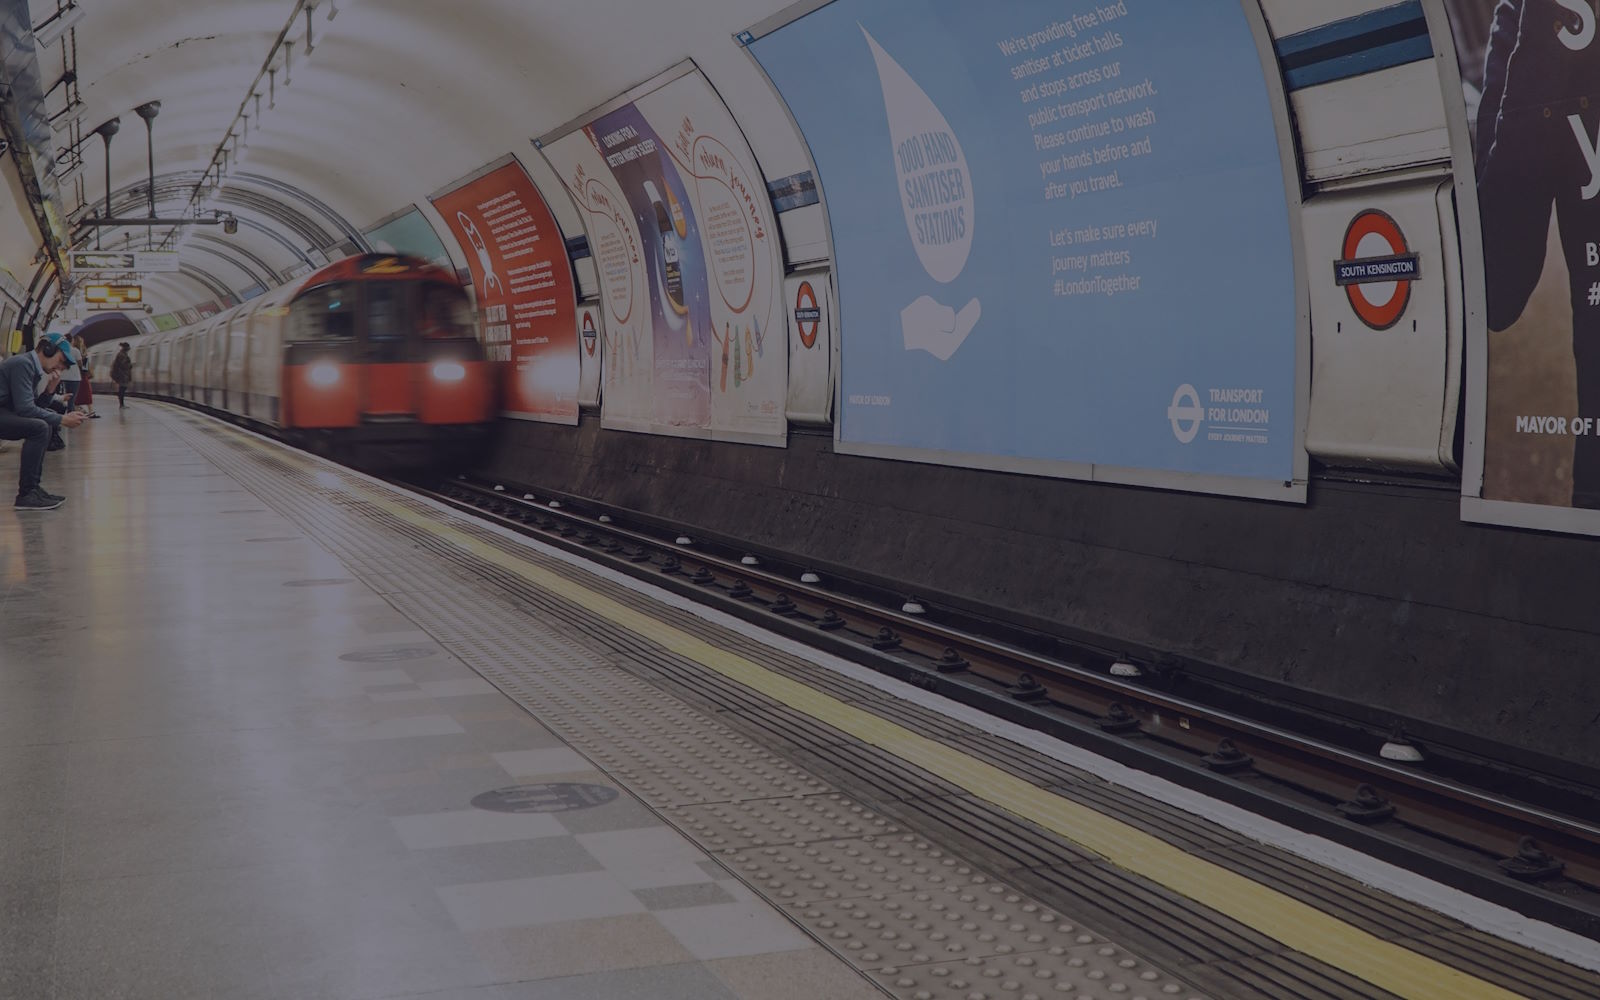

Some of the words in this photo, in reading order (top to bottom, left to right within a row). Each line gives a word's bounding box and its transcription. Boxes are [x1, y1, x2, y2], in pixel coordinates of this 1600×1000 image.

[997, 37, 1028, 57] We're
[1027, 22, 1077, 51] providing
[1073, 12, 1099, 31] free
[1098, 0, 1128, 20] hand
[1010, 56, 1050, 80] sanitiser
[1053, 51, 1065, 67] at
[1063, 41, 1095, 63] ticket
[1093, 31, 1123, 52] halls
[1020, 83, 1039, 103] and
[1040, 76, 1067, 97] stops
[1068, 67, 1101, 89] across
[1103, 62, 1120, 79] our
[1028, 104, 1058, 130] public
[1058, 92, 1107, 118] transport
[1107, 78, 1158, 106] network.
[1034, 129, 1065, 151] Please
[1067, 120, 1111, 144] continue
[1111, 117, 1124, 132] to
[1125, 107, 1157, 128] wash
[897, 136, 925, 174] 1000
[920, 131, 957, 166] HAND
[1040, 159, 1060, 179] your
[1062, 149, 1093, 170] hands
[1093, 143, 1129, 164] before
[1130, 136, 1152, 155] and
[905, 168, 965, 209] SANITISER
[1045, 180, 1067, 199] after
[1070, 178, 1088, 199] you
[1089, 170, 1124, 191] travel.
[914, 206, 965, 246] STATIONS
[1050, 226, 1072, 247] Let's
[1074, 224, 1100, 243] make
[1102, 223, 1125, 240] sure
[1127, 217, 1159, 238] every
[1052, 252, 1088, 275] journey
[1090, 249, 1130, 267] matters
[1341, 265, 1366, 277] SOUTH
[1367, 261, 1414, 275] KENSINGTON
[1053, 274, 1141, 296] #LondonTogether
[1208, 407, 1226, 422] FOR
[1228, 408, 1269, 423] LONDON
[1209, 388, 1263, 404] TRANSPORT
[1516, 415, 1568, 435] MAYOR
[1571, 417, 1593, 436] OF
